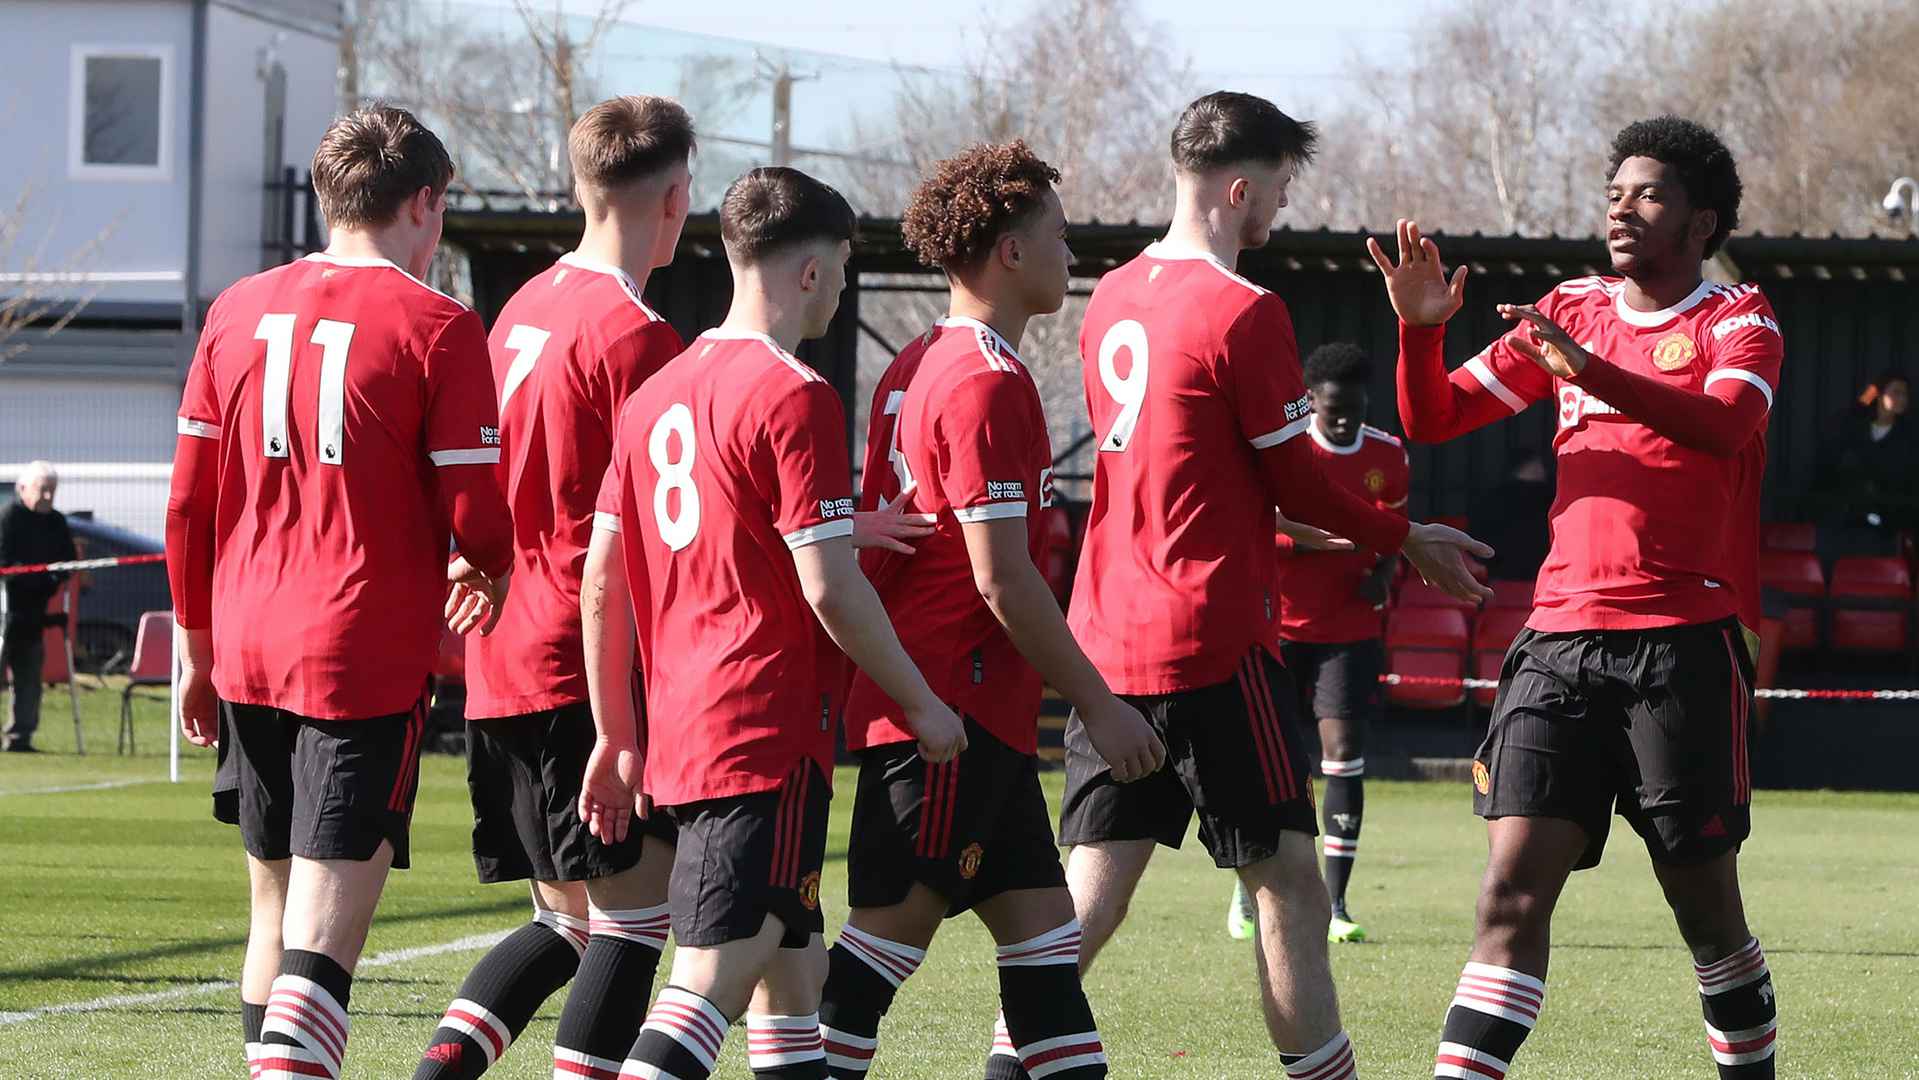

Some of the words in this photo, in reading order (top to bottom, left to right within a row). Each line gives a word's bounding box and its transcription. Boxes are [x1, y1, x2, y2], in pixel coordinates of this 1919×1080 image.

[500, 324, 551, 416] 7
[1712, 313, 1781, 340] KOHLER
[253, 313, 356, 465] 11
[1098, 319, 1149, 452] 9
[648, 402, 701, 552] 8
[820, 500, 834, 509] No
[987, 481, 1002, 490] No
[1003, 482, 1021, 490] room
